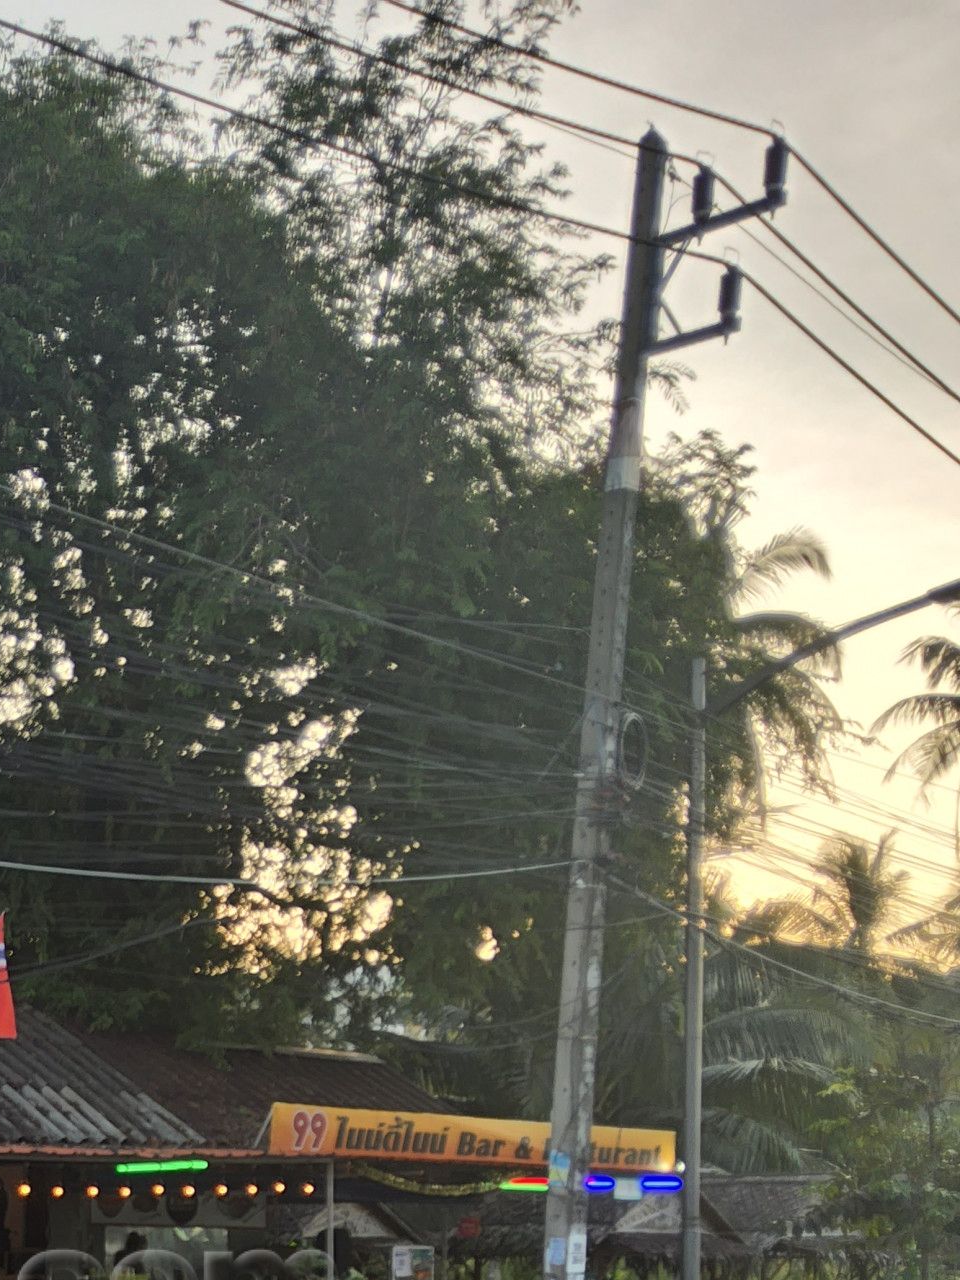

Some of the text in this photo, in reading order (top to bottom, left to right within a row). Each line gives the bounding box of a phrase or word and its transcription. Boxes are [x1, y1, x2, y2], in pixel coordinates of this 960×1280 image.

[292, 1110, 328, 1152] 99
[456, 1131, 506, 1157] Bar
[515, 1136, 533, 1159] &
